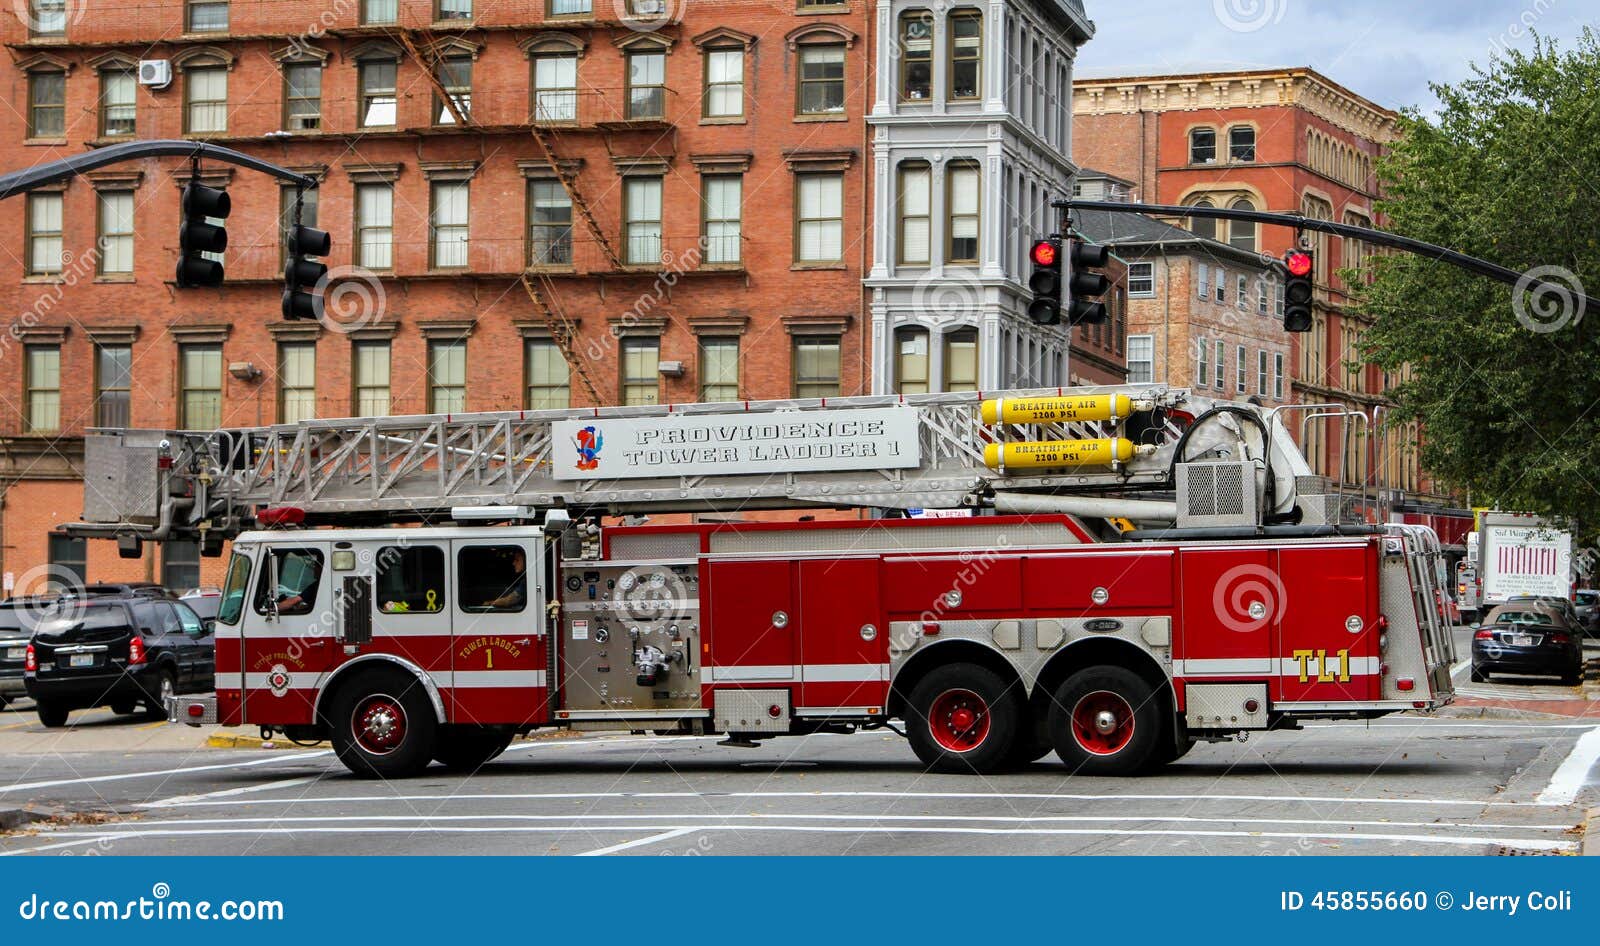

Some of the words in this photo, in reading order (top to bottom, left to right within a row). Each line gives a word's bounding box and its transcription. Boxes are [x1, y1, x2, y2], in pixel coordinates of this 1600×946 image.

[1013, 402, 1073, 411] BREATHING
[1078, 400, 1097, 408] AIR
[1033, 411, 1056, 419] 2200
[1060, 410, 1077, 418] PSI
[636, 419, 885, 446] PROVIDENCE
[623, 446, 741, 467] TOWER
[749, 440, 879, 463] LADDER
[887, 440, 901, 457] 1
[1080, 443, 1099, 451] AIR
[1035, 454, 1057, 462] 2200
[460, 637, 488, 659] TOWER
[489, 636, 521, 658] LADDER
[485, 648, 493, 668] 1
[1293, 649, 1351, 683] TL1
